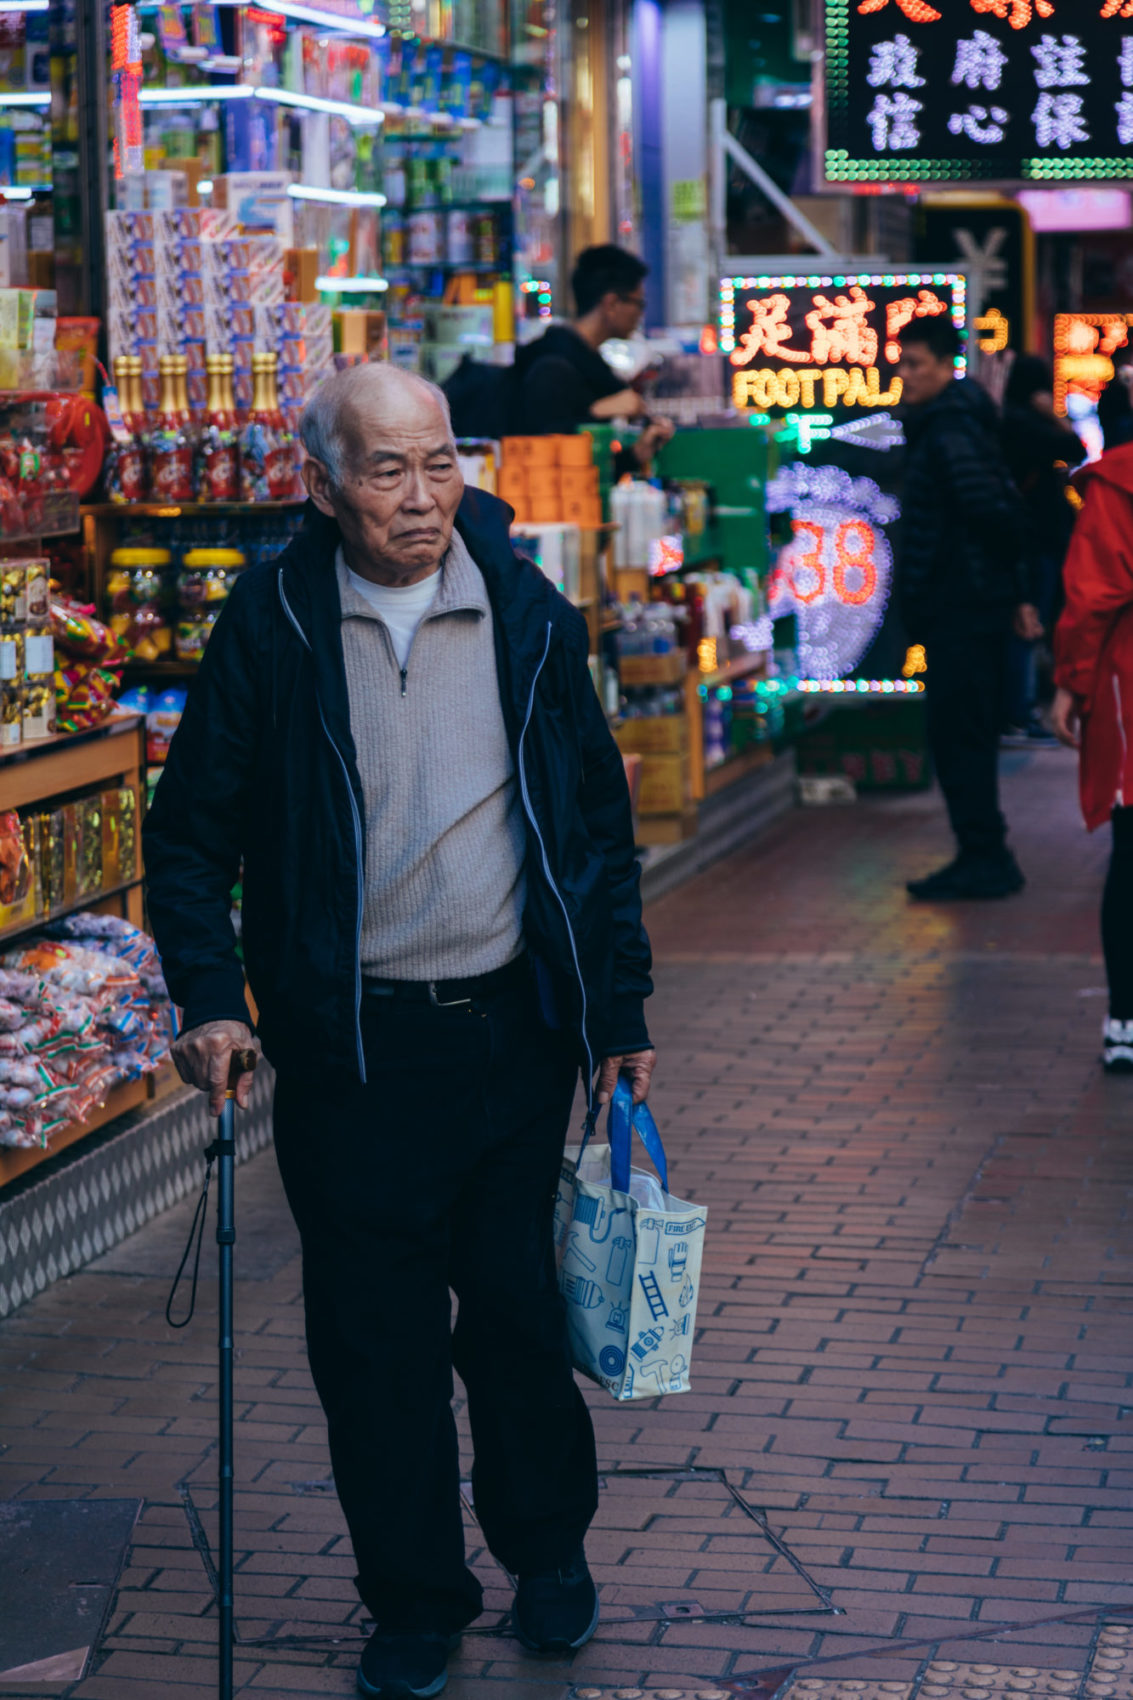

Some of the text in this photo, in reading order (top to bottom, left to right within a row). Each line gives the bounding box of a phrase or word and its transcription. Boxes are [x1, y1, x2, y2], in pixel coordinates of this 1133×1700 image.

[866, 29, 1133, 91] 政府註
[865, 91, 1133, 151] 信心保
[732, 368, 823, 408] FOOT
